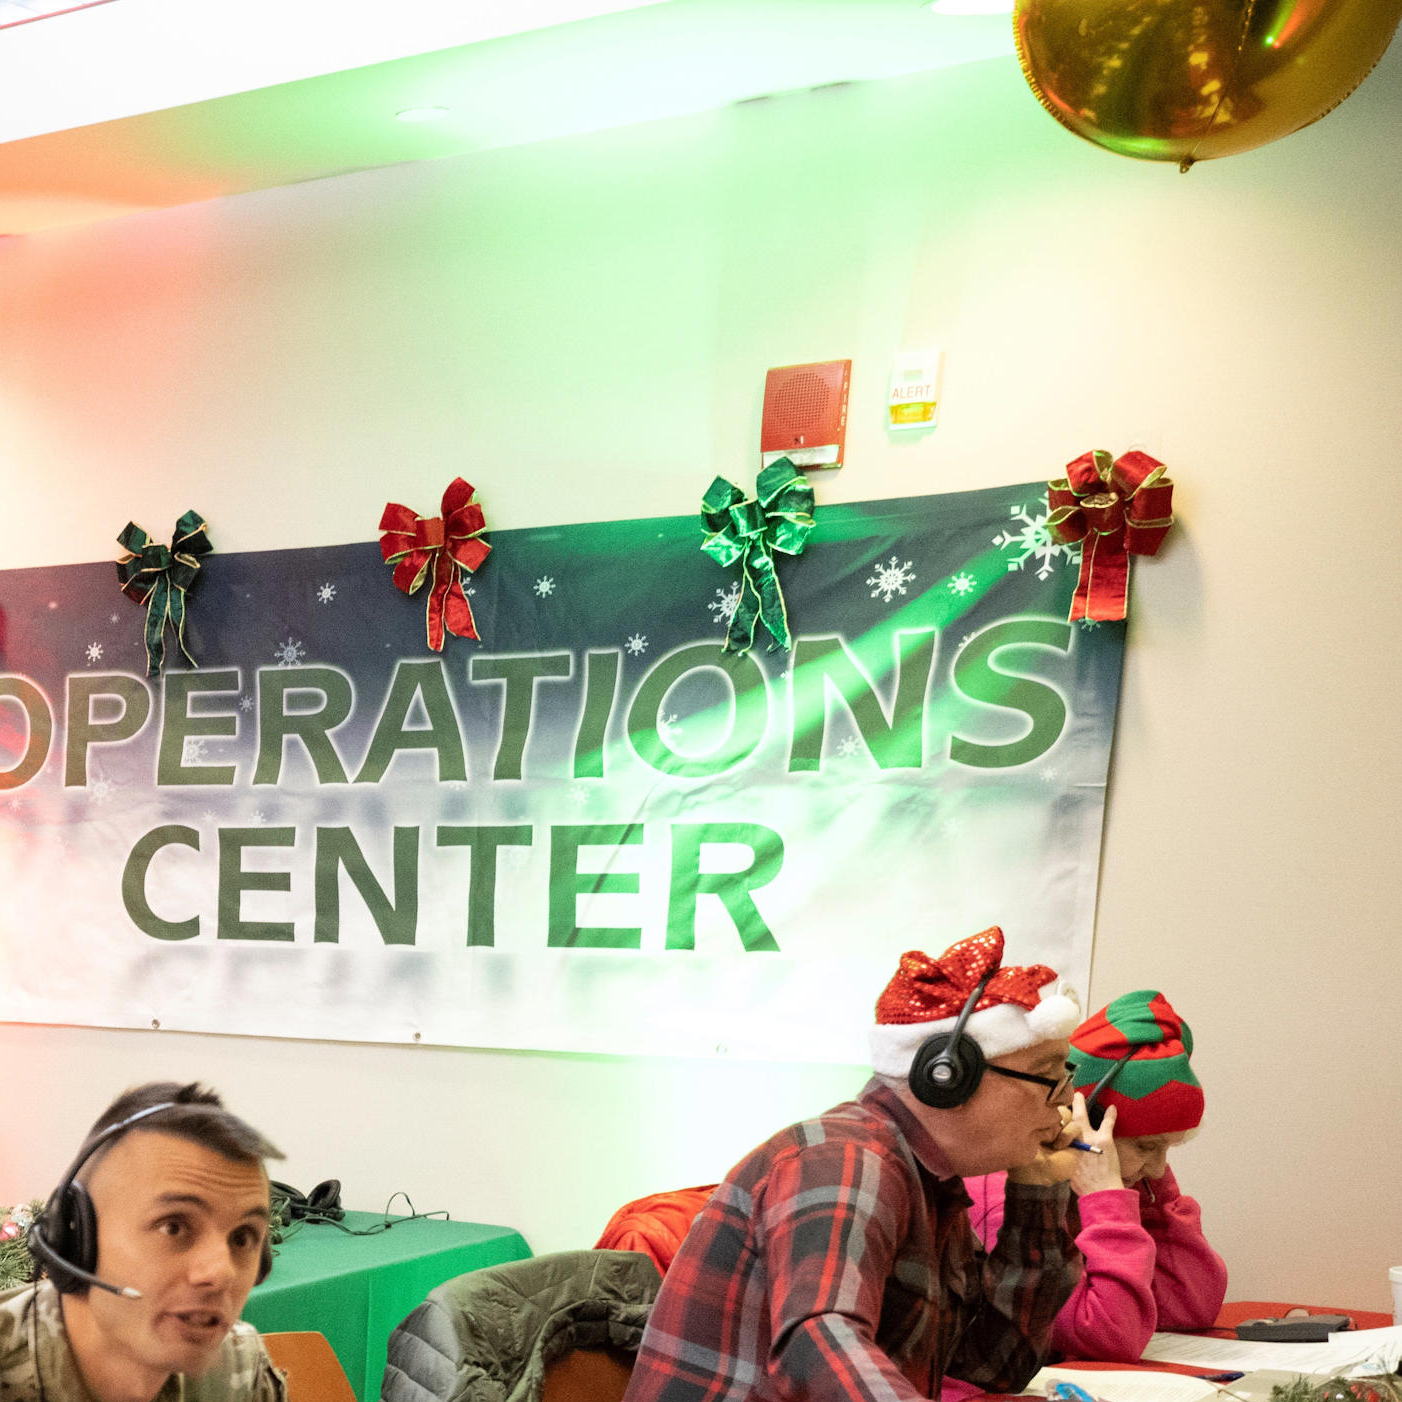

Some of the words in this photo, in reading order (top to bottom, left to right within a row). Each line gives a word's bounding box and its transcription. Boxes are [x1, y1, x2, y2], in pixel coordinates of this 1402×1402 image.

[840, 381, 848, 426] FIRE
[891, 384, 932, 400] ALERT
[119, 821, 788, 955] CENTER
